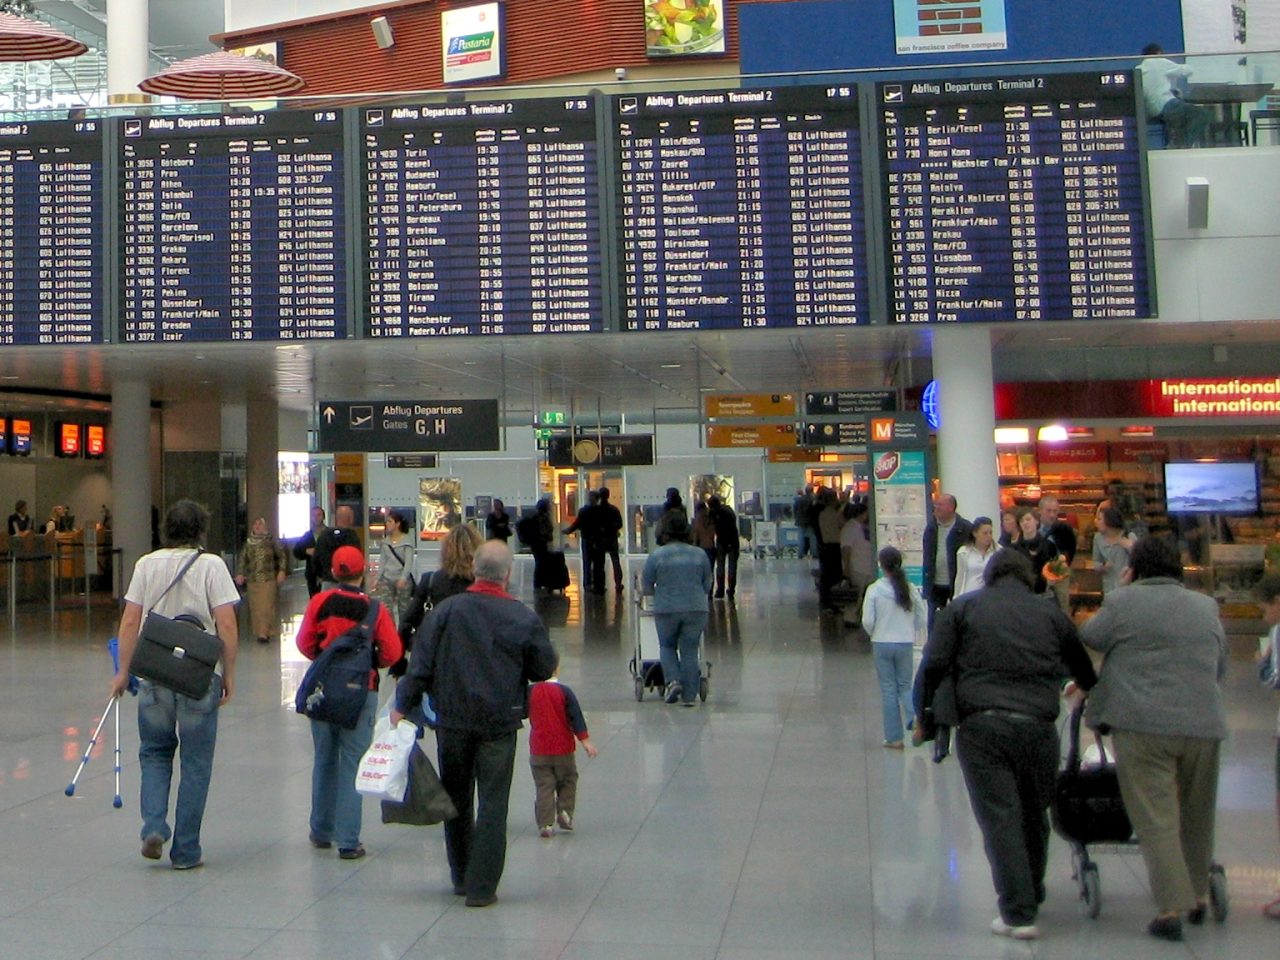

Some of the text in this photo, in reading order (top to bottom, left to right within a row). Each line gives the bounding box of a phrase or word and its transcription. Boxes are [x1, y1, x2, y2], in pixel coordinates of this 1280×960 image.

[912, 79, 1043, 94] Abflug Departures Terminal 2
[646, 92, 772, 107] Abflug Departures Terminal 2
[392, 105, 512, 119] Abflug Departures Terminal 2
[149, 115, 264, 130] Abflug Departures Terminal 2
[927, 118, 1123, 135] Berlin/Tegel 21:30 Lufthansa
[22, 126, 28, 134] 2
[735, 134, 758, 143] 21:05
[805, 131, 847, 140] Lufthansa
[928, 137, 951, 146] Seoul
[406, 143, 584, 157] Turin 19:30 Lufthansa
[952, 157, 989, 168] Nächster
[1021, 156, 1040, 165] Next
[737, 180, 760, 188] 21:10
[55, 195, 91, 203] Lufthansa
[162, 190, 193, 199] Istanbul
[665, 249, 763, 259] Düsseldorf 21:20
[934, 253, 972, 262] Lissabon
[162, 265, 251, 275] Florenz 19:25
[408, 269, 502, 280] Verona 20:55
[935, 272, 1133, 286] Florenz Lufthansa
[936, 299, 1002, 309] Frankfurt/Main
[162, 308, 334, 319] Frankfurt/Main 19:30 Lufthansa
[481, 314, 503, 322] 21:00
[1161, 379, 1280, 395] International
[383, 405, 463, 417] Abflug Departures
[383, 420, 408, 430] Gates
[434, 420, 446, 434] H
[876, 425, 891, 438] M
[875, 456, 896, 473] SHOP
